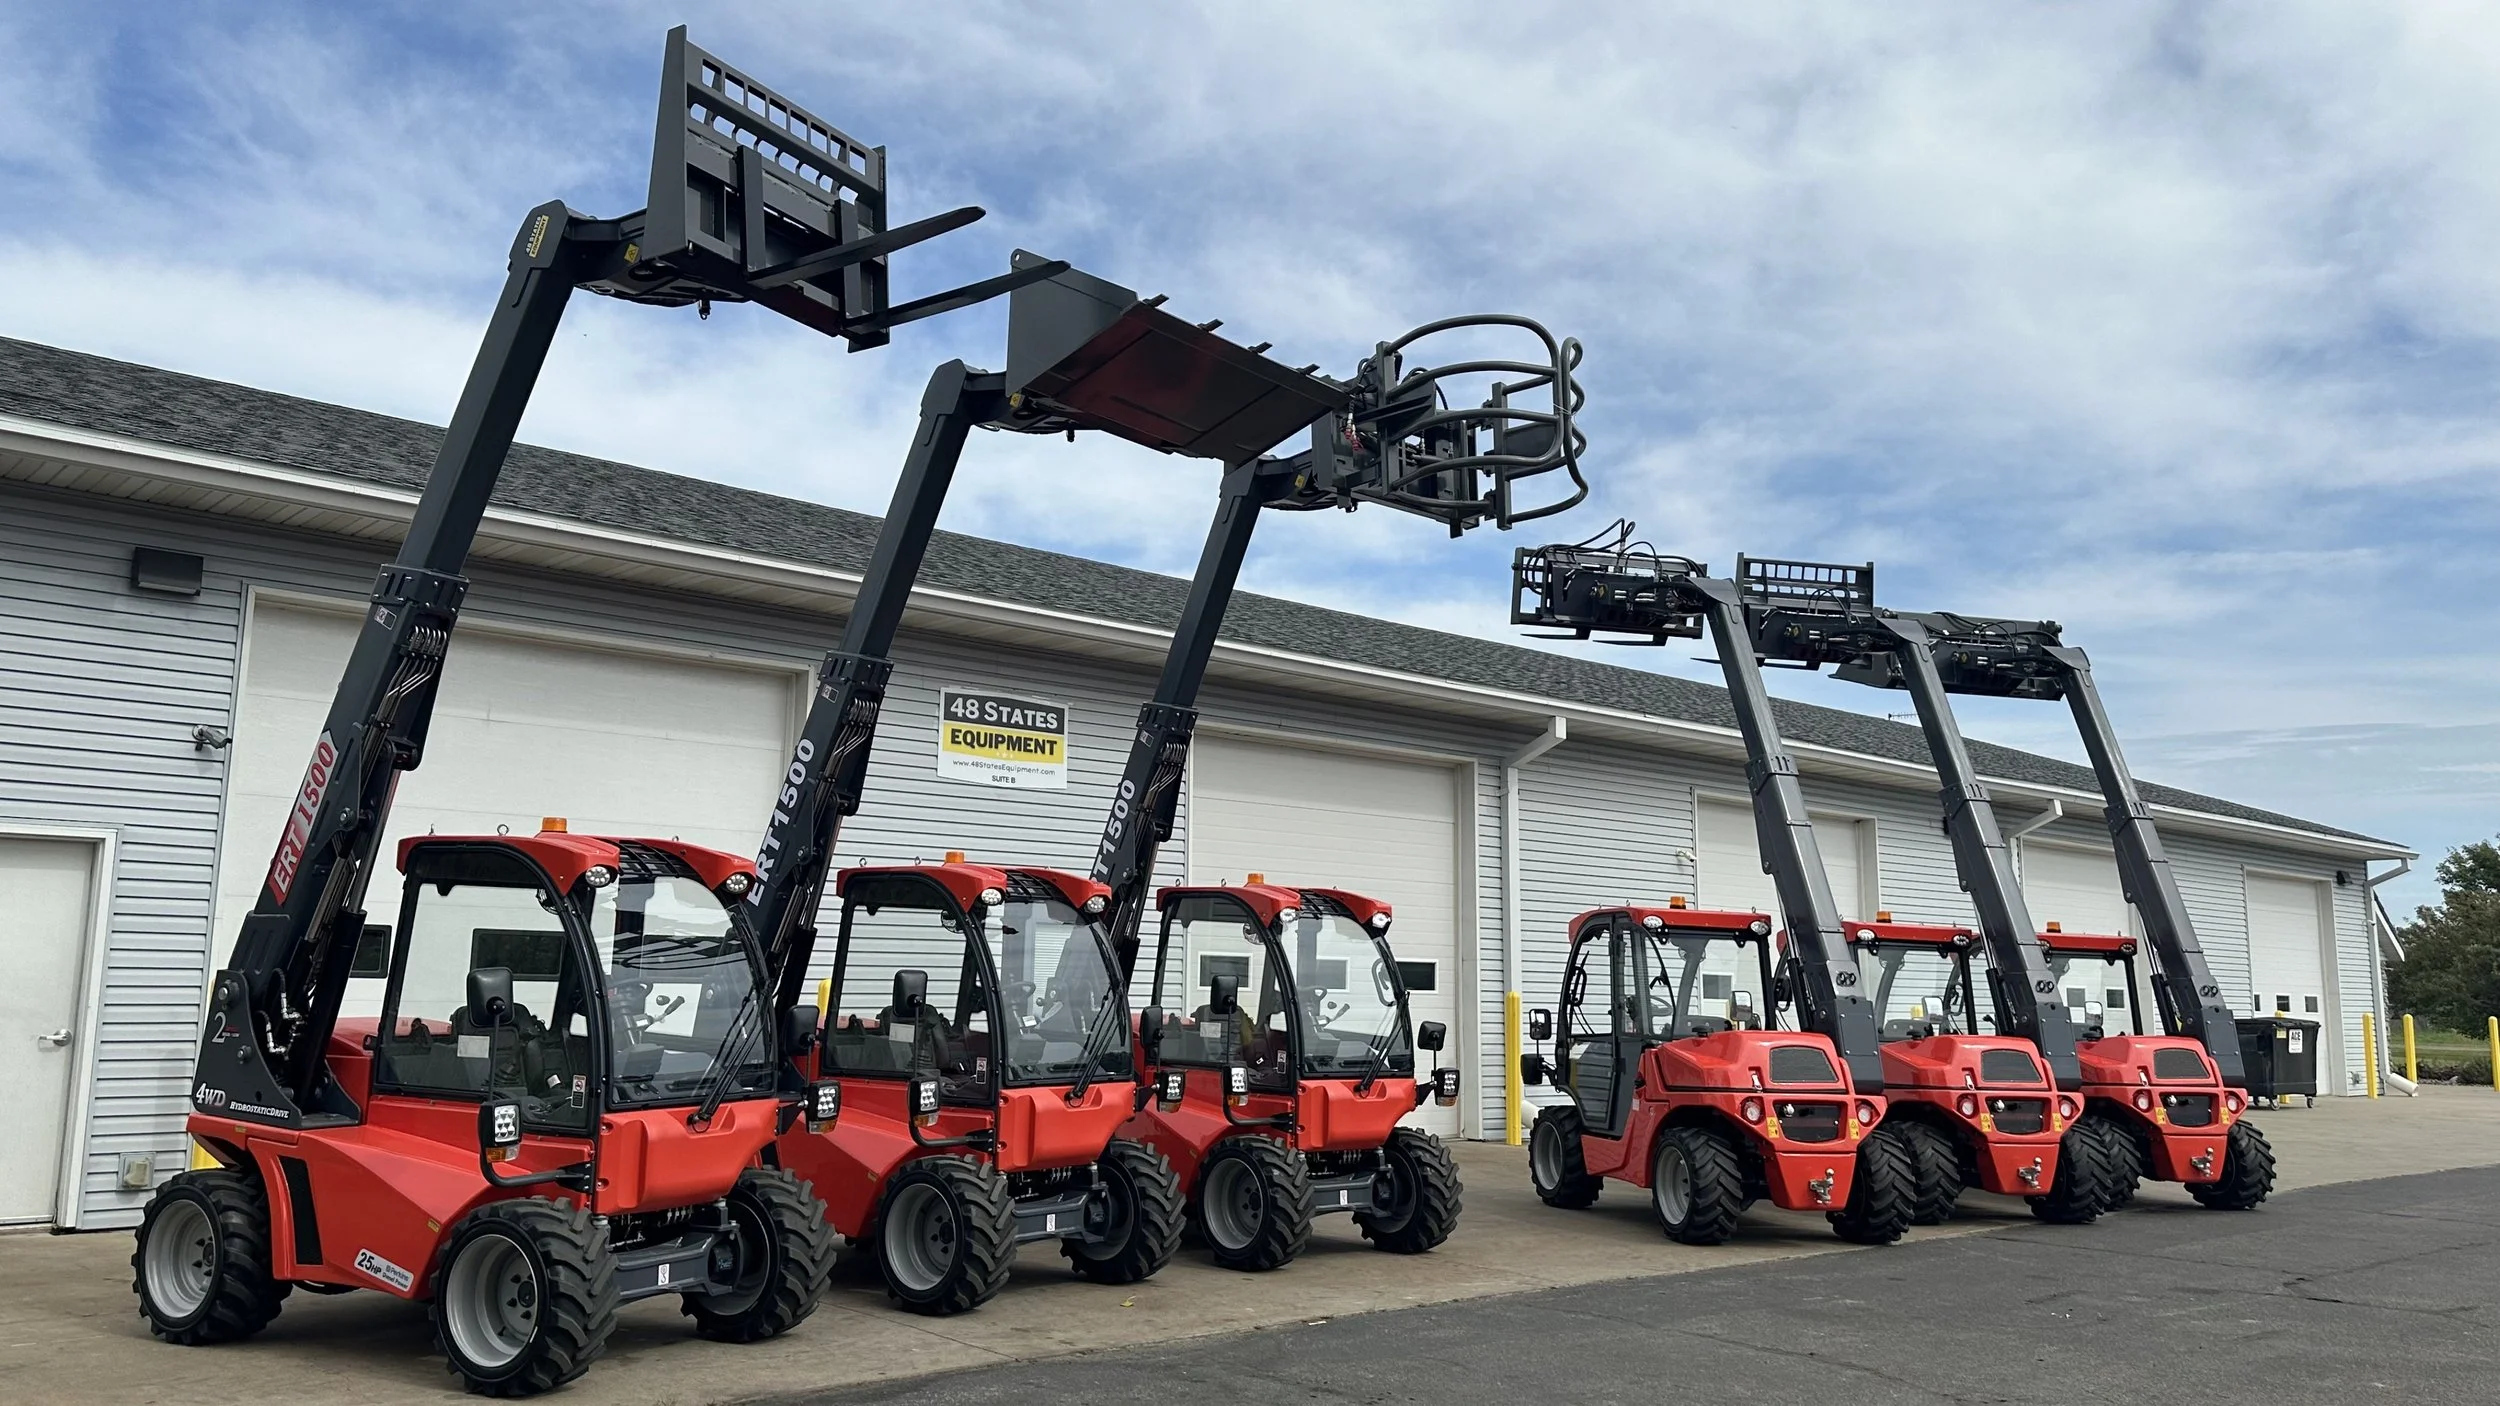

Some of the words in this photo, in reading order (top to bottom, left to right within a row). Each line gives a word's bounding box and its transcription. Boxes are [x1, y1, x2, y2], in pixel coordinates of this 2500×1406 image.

[950, 697, 979, 720] 48
[983, 701, 1058, 729] STATES
[950, 728, 1058, 756] EQUIPMENT
[952, 759, 1056, 776] www.48StatesEquipment.com
[991, 775, 1010, 784] SUITE
[274, 823, 302, 894] ERT
[298, 741, 334, 827] 1500
[1092, 779, 1135, 885] T1500
[211, 1011, 227, 1043] 2
[196, 1082, 226, 1106] 4WD
